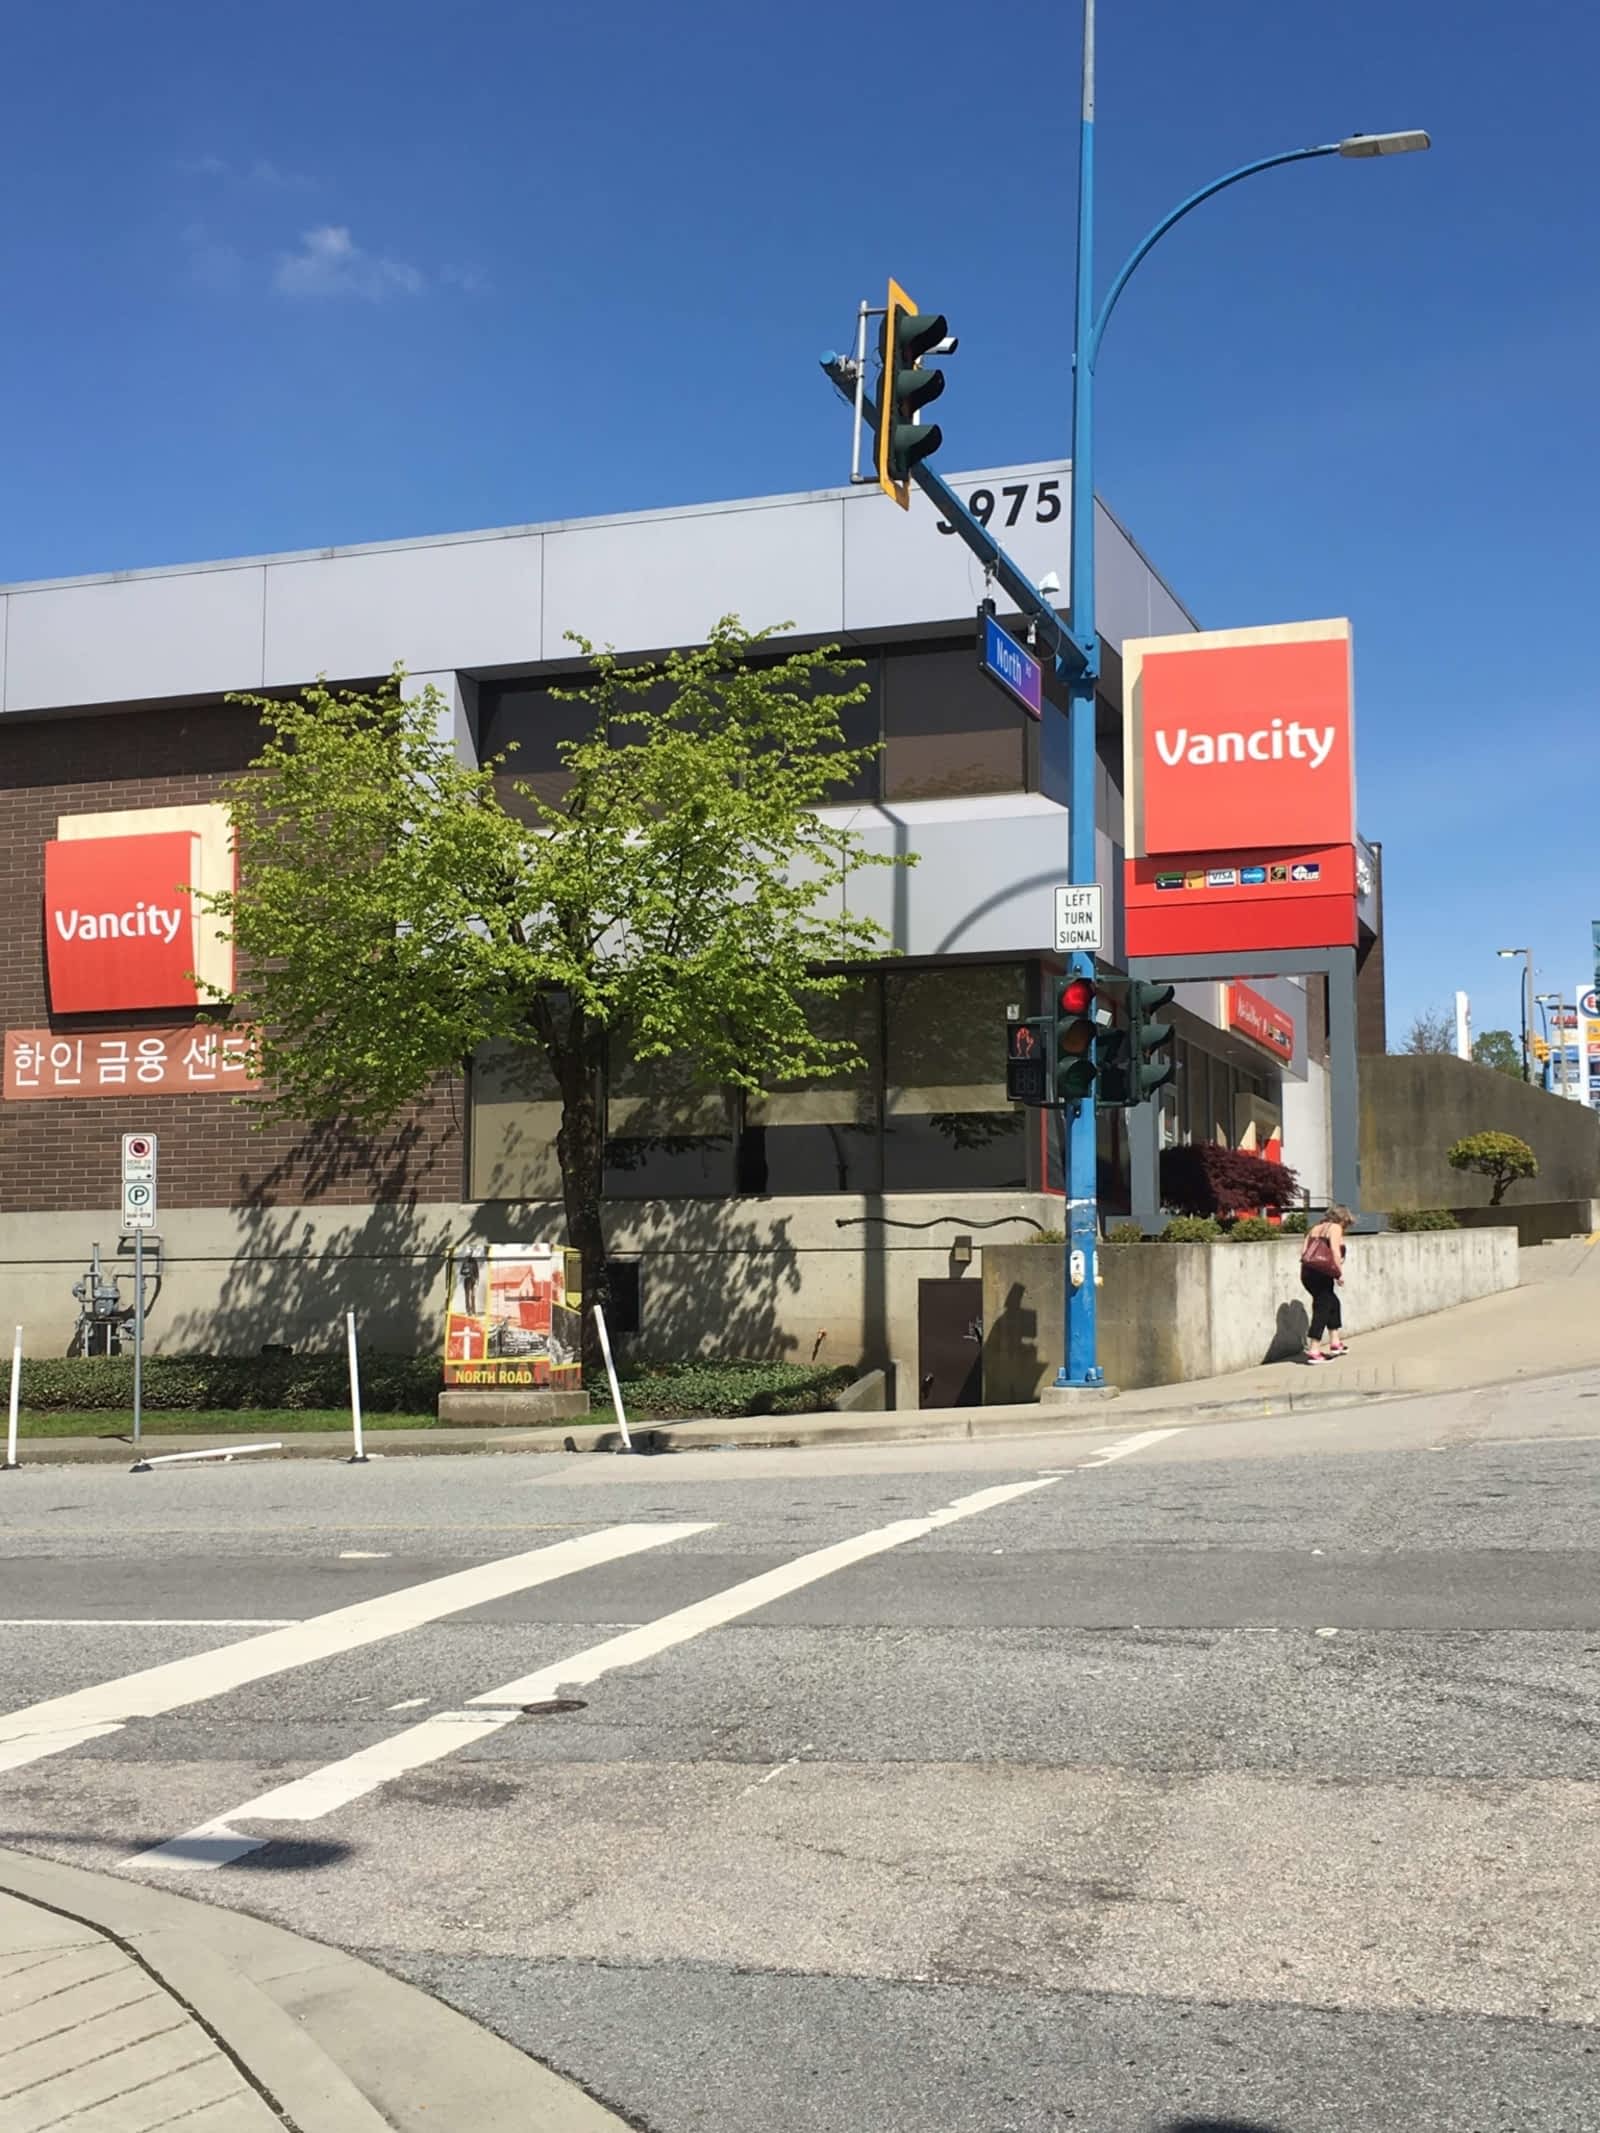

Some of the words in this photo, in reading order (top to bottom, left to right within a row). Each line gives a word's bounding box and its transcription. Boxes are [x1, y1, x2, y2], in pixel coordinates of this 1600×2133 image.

[936, 480, 1061, 535] 975
[997, 637, 1022, 687] North
[1155, 718, 1335, 769] Vancity
[1212, 871, 1234, 880] VISA
[1065, 893, 1092, 907] LEFT
[54, 901, 182, 944] Vancity
[1064, 911, 1093, 925] TURN
[1059, 930, 1098, 944] SIGNAL
[13, 1039, 83, 1086] 한인
[96, 1038, 168, 1084] 금융
[455, 1370, 496, 1384] NORTH
[499, 1370, 532, 1384] ROAD
